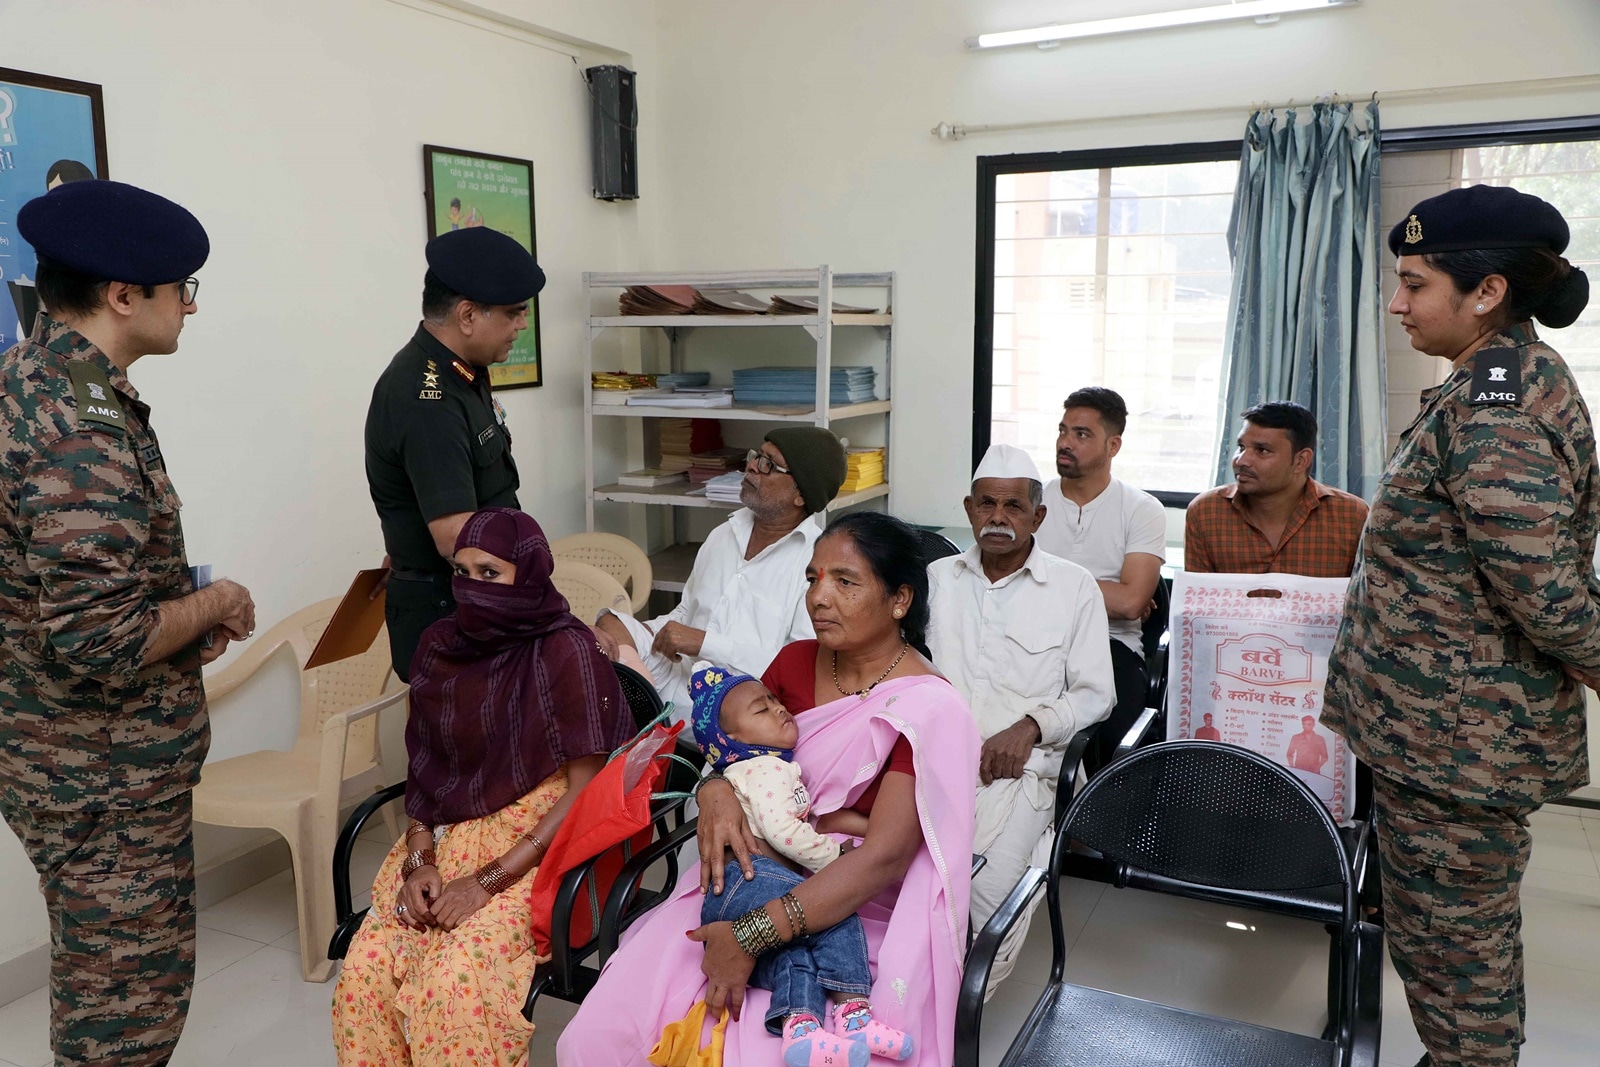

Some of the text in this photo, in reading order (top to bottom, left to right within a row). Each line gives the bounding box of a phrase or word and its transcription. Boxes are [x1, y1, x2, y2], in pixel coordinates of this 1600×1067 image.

[418, 389, 442, 400] AMC
[1474, 391, 1516, 402] AMC
[86, 405, 119, 419] AMC
[1240, 646, 1283, 666] बर्वे
[1240, 666, 1286, 680] BARVE
[1228, 688, 1296, 707] क्लॉथ सेंटर
